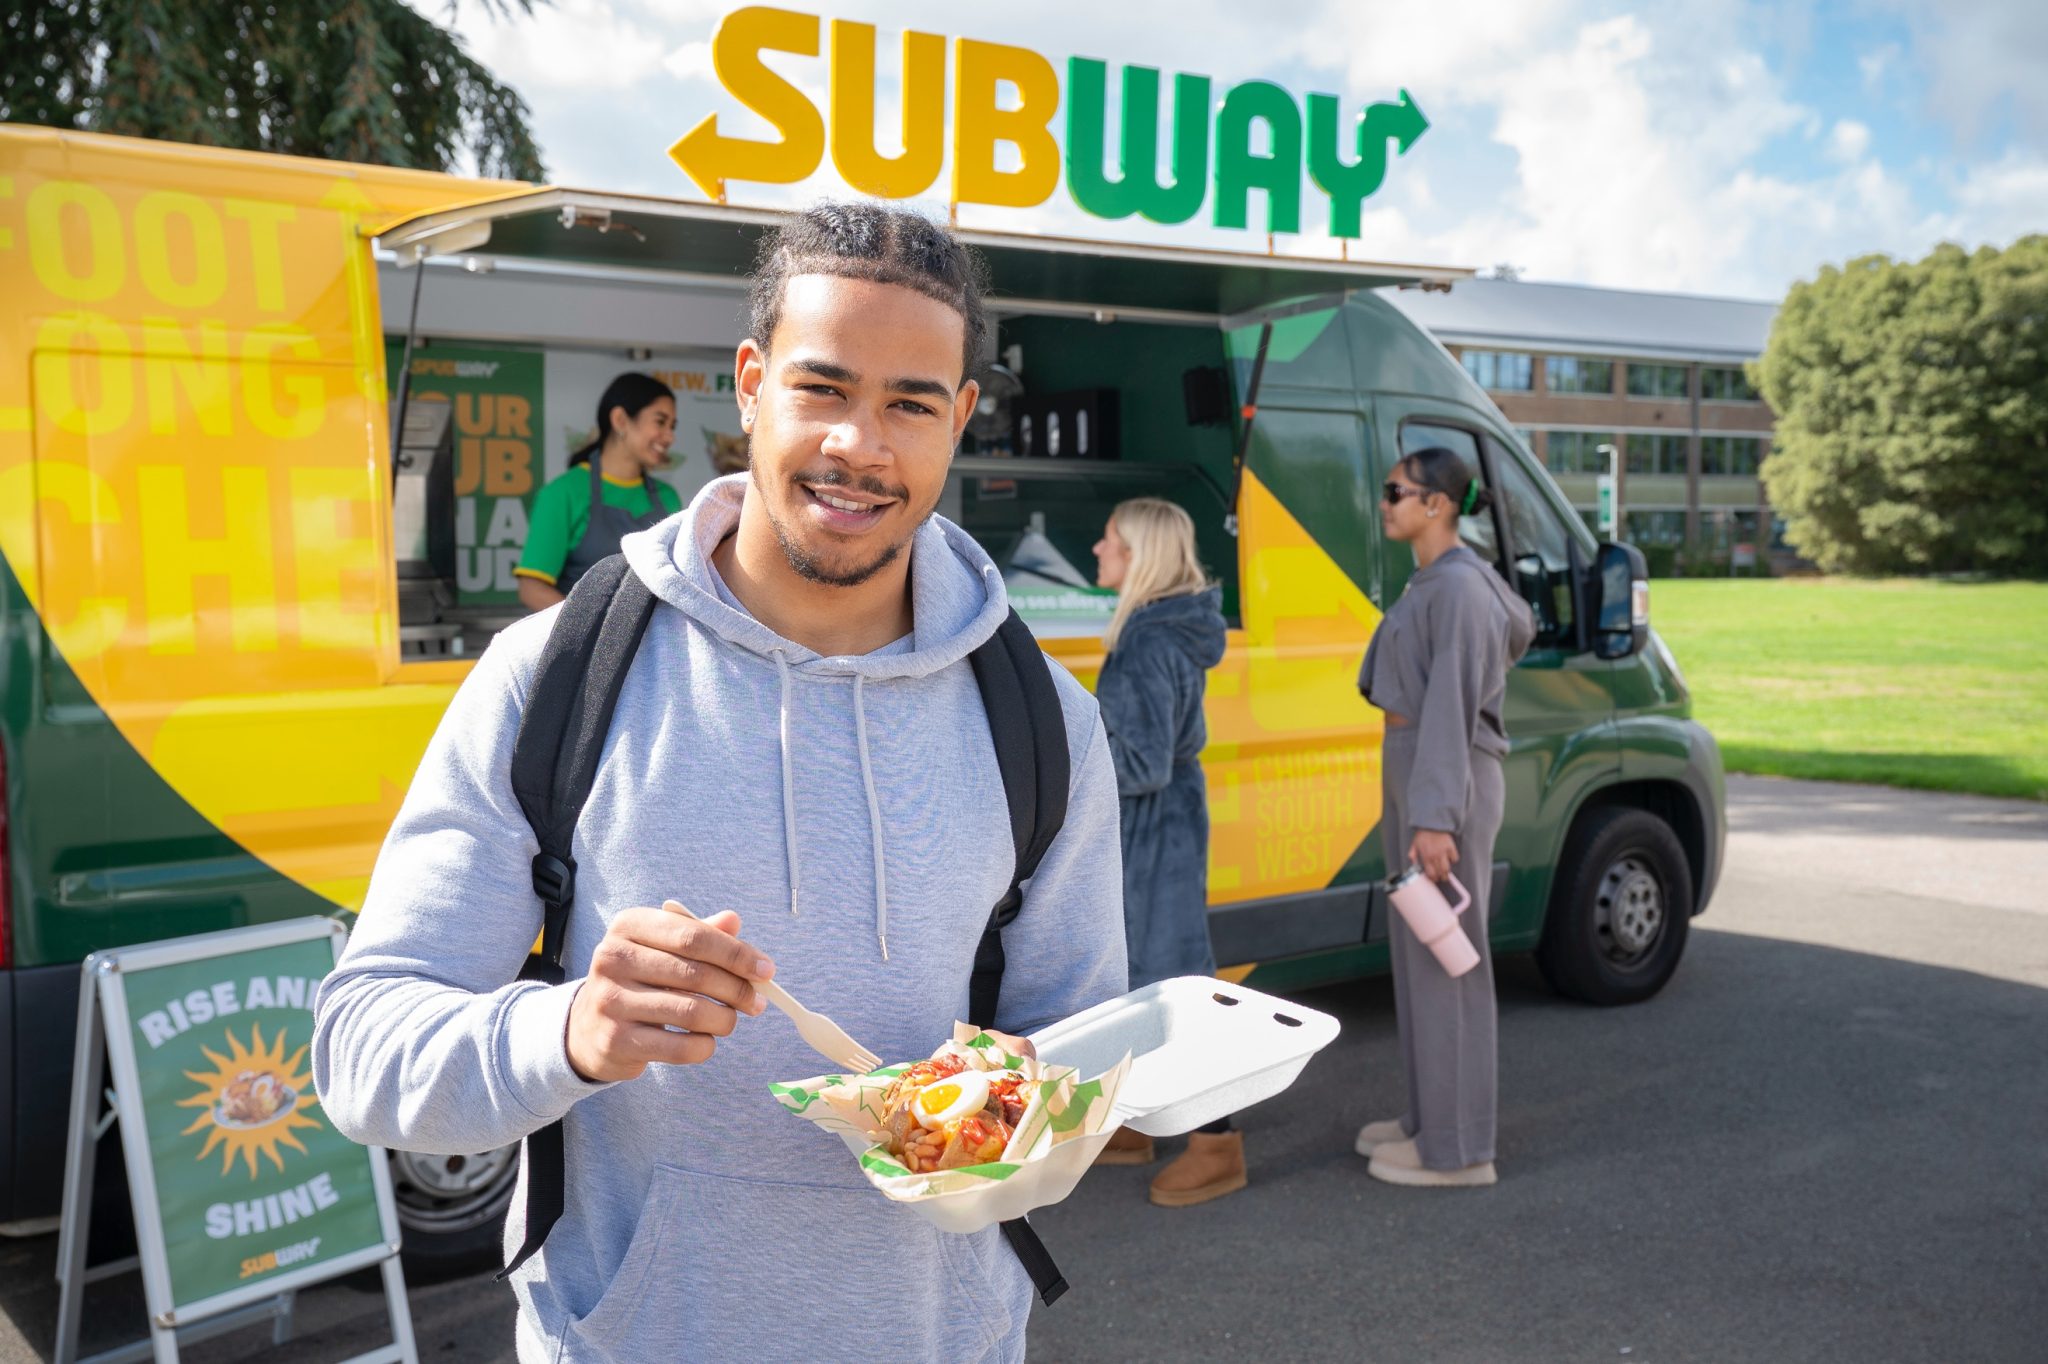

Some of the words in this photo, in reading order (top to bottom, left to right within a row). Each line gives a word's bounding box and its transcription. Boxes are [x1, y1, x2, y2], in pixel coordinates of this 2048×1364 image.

[666, 5, 1431, 239] SUBWAY
[1255, 788, 1354, 838] SOUTH
[1255, 831, 1336, 881] WEST
[138, 980, 241, 1049] RISE
[204, 1172, 340, 1239] SHINE
[239, 1237, 322, 1279] SUBWAY
